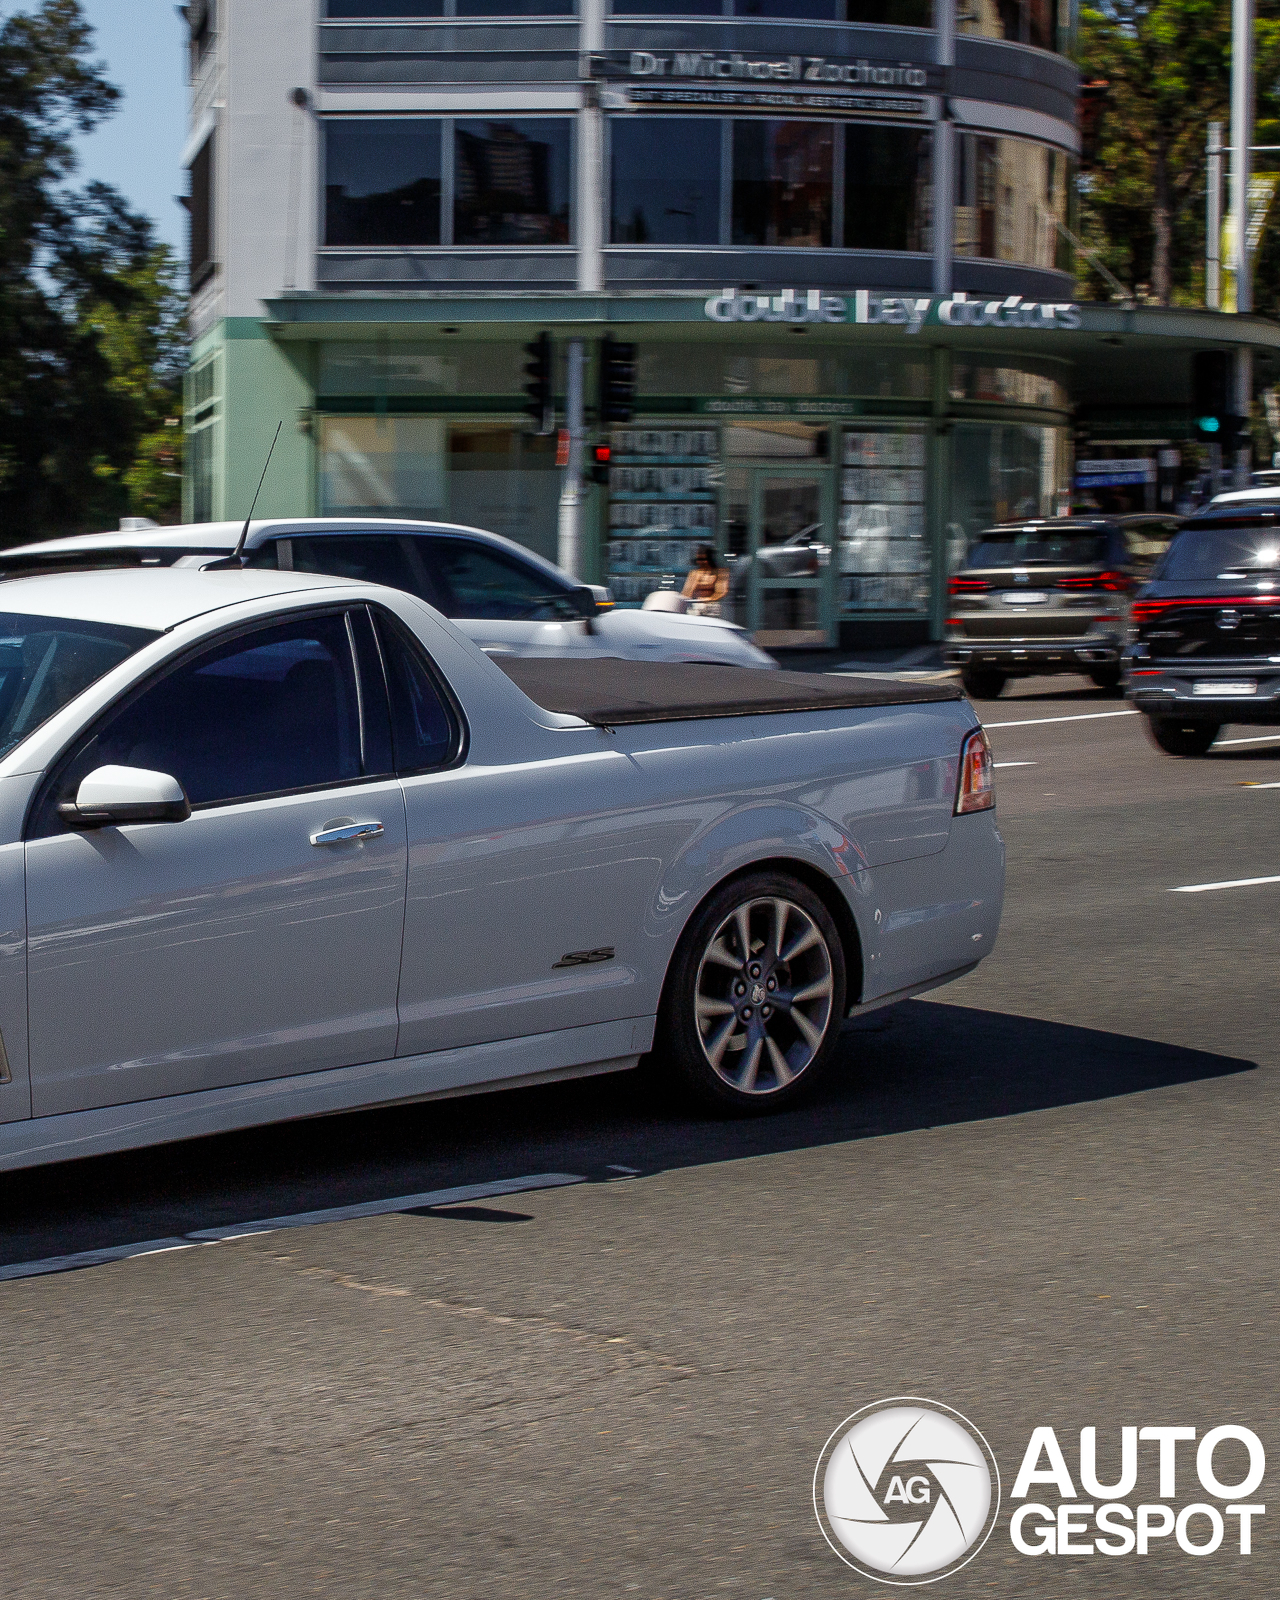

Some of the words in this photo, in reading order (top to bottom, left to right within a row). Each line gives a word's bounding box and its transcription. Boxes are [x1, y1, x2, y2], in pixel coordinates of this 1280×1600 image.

[705, 288, 848, 322] double
[854, 289, 930, 334] bay
[937, 292, 1081, 329] doctors
